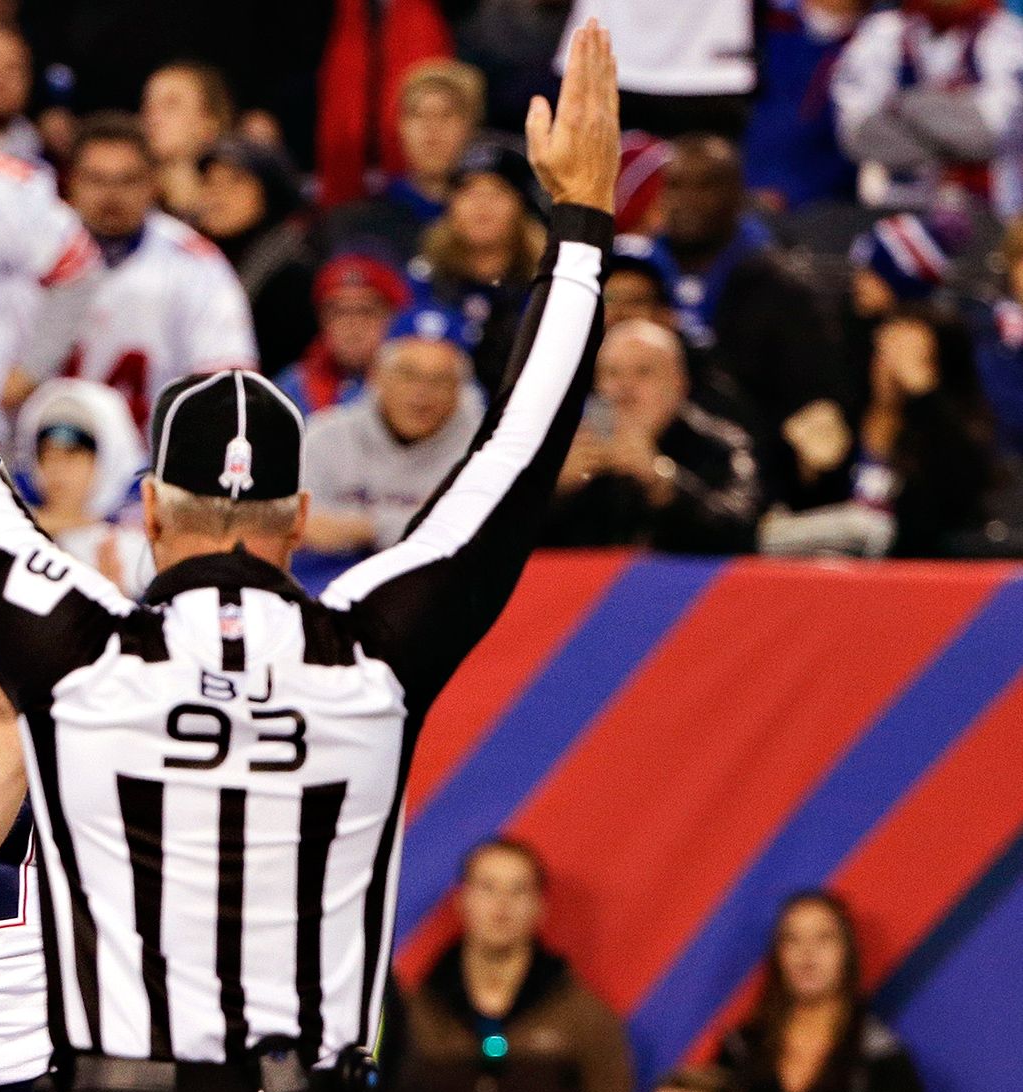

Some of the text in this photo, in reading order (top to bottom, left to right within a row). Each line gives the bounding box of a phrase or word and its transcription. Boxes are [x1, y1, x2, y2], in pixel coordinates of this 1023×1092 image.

[26, 550, 69, 582] 3
[201, 664, 272, 703] BJ
[163, 703, 306, 772] 93
